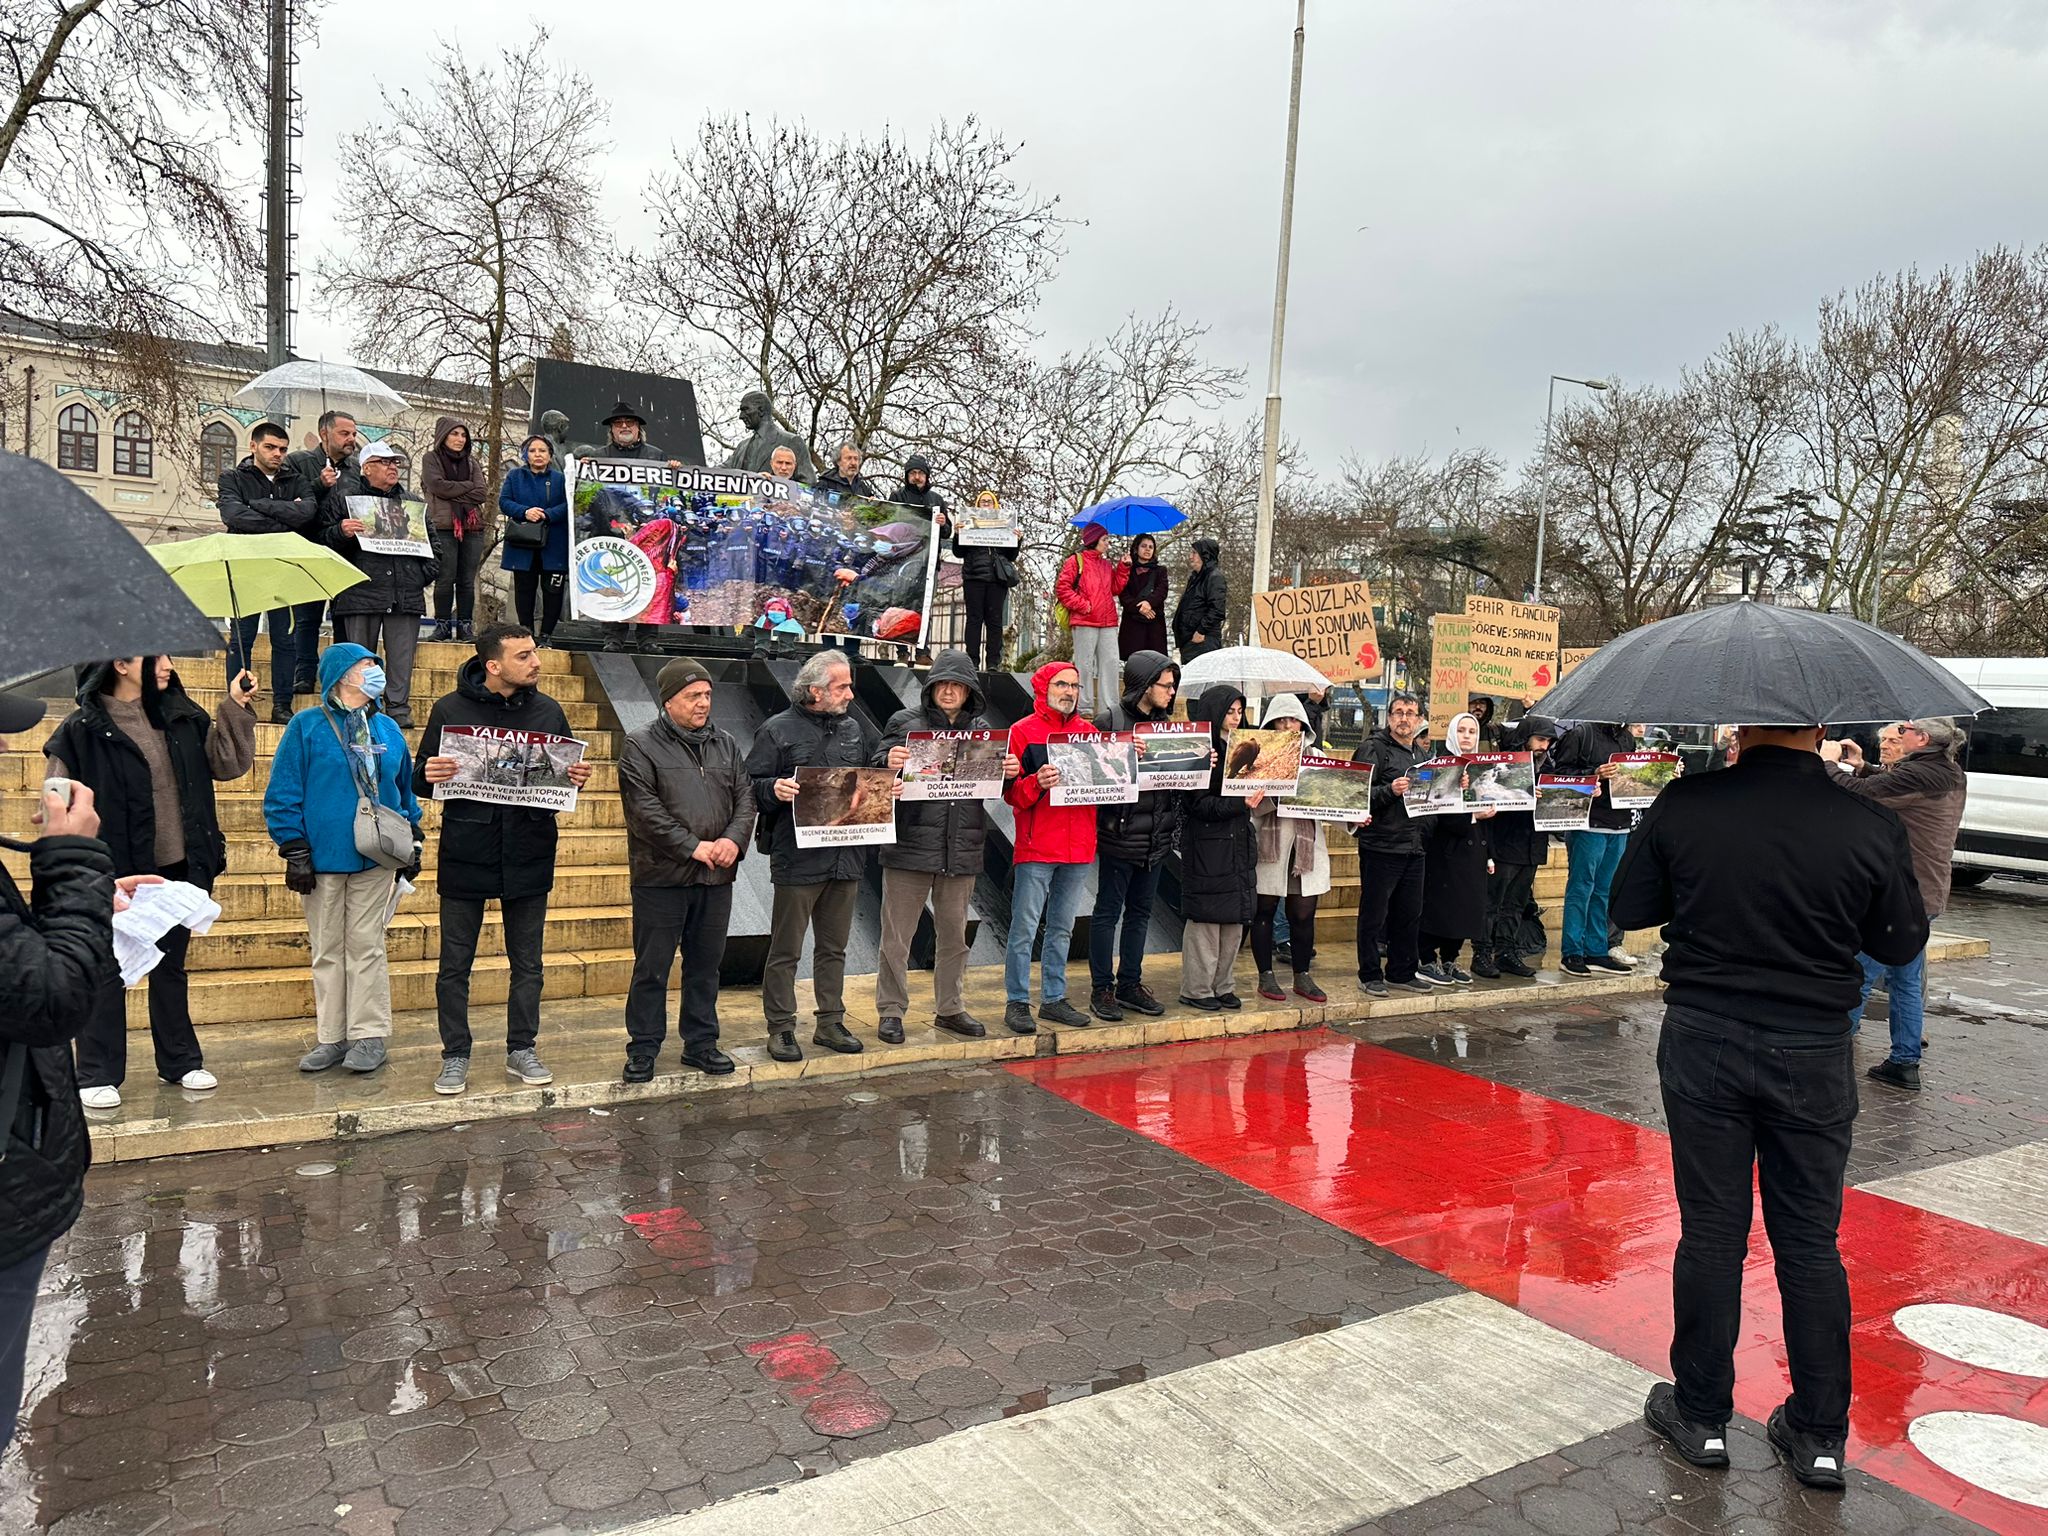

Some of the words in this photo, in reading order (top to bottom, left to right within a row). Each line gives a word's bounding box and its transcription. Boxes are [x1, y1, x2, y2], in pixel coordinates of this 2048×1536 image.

[677, 469, 789, 500] DİRENİYOR
[592, 541, 625, 552] ÇEVRE
[1262, 583, 1366, 618] YOLSUZLAR
[1260, 618, 1312, 644] YOLUN
[1315, 611, 1373, 635] SONUNA
[1292, 633, 1350, 659] GELDİ!
[1435, 669, 1467, 689] YAŞAM
[1476, 674, 1528, 690] ÇOCUKLARI
[1151, 722, 1184, 732] YALAN
[1191, 723, 1197, 732] 7
[470, 726, 529, 744] YALAN
[545, 734, 563, 744] 10
[931, 731, 973, 740] YALAN
[982, 731, 991, 741] 9
[1067, 732, 1102, 743] YALAN
[1110, 732, 1117, 742] 8
[1302, 757, 1336, 766] YALAN
[1476, 754, 1501, 762] YALAN
[439, 782, 495, 792] DEPOLANAN
[497, 786, 533, 795] VERİMLİ
[535, 788, 571, 798] TOPRAK
[927, 782, 950, 790] DOĞA
[1065, 788, 1079, 796] ÇAY
[1080, 786, 1125, 795] BAHÇELERİNE
[442, 789, 478, 797] TEKRAR
[481, 791, 513, 801] YERİNE
[928, 790, 974, 798] OLMAYACAK
[1064, 795, 1126, 804] DOKUNULMAYACAK
